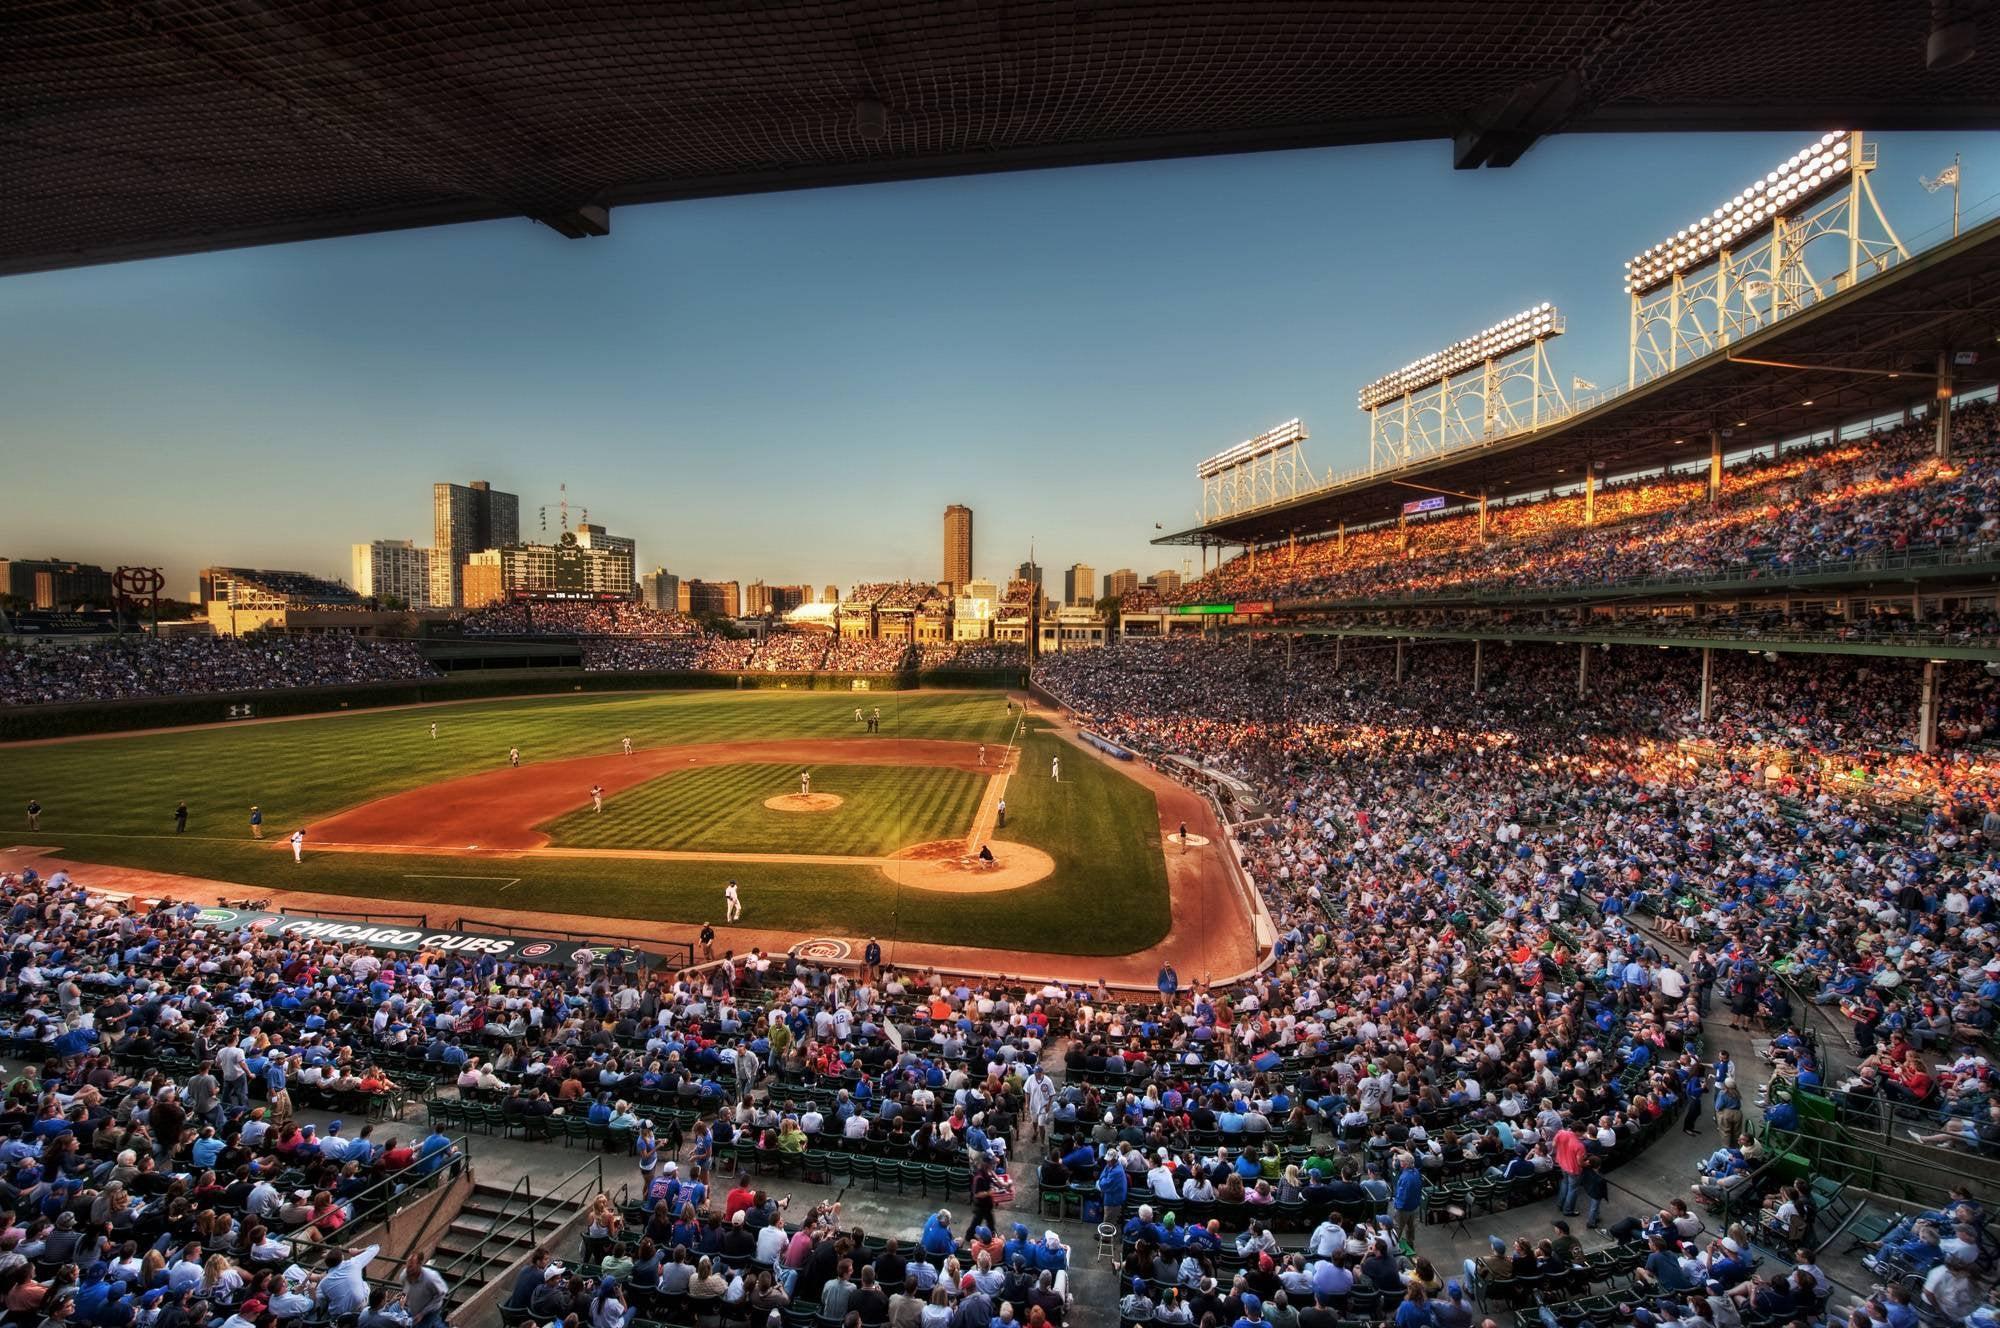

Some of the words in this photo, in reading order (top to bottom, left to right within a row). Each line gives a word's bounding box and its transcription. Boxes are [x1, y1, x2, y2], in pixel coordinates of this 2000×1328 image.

[279, 921, 422, 944] CHICAGO
[420, 935, 515, 953] CUBS
[836, 1014, 845, 1024] 12
[1367, 1088, 1381, 1098] 72
[651, 1182, 669, 1199] 29
[678, 1187, 693, 1202] 21
